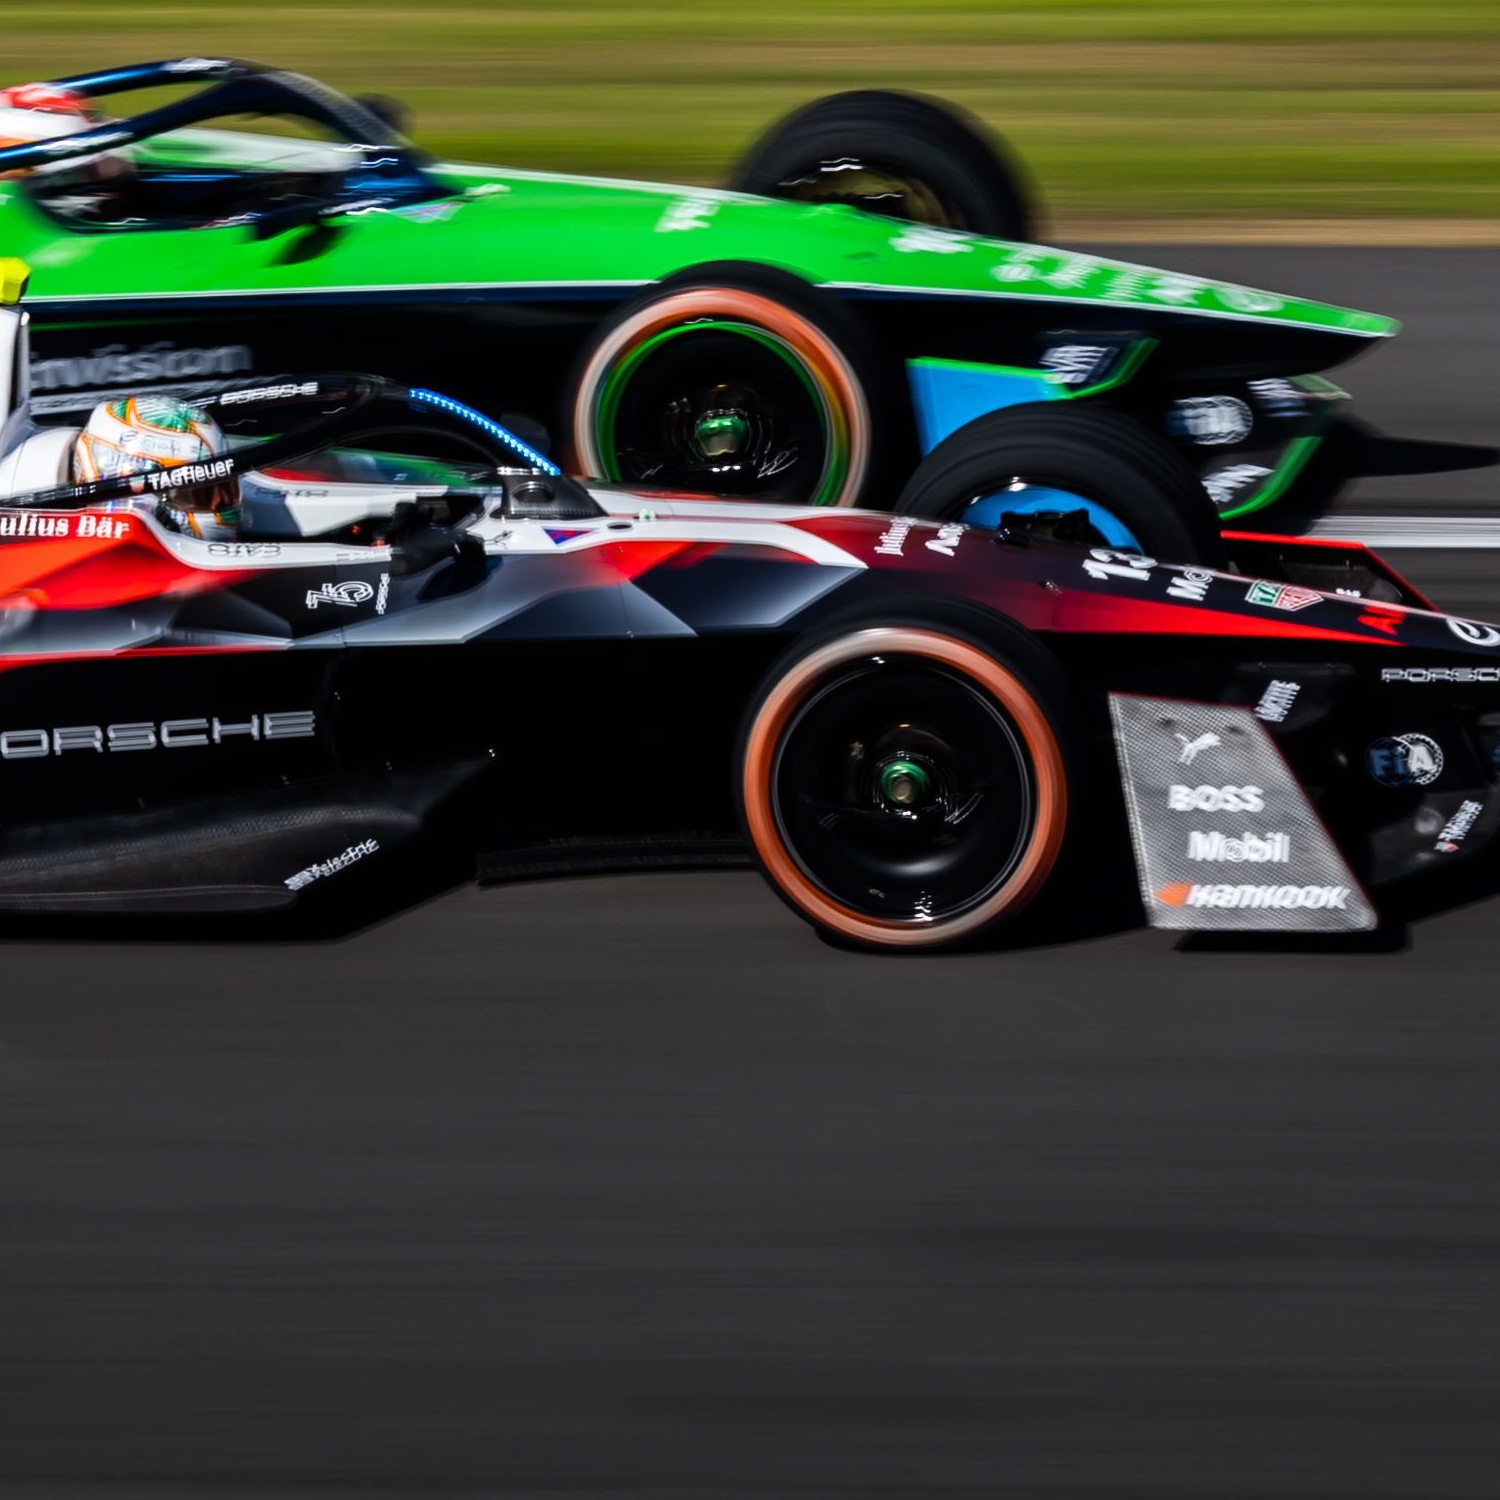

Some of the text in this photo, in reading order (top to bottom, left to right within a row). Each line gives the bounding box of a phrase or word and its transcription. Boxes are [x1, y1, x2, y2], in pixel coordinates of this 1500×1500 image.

[76, 515, 130, 540] Bär
[1168, 785, 1265, 812] BOSS
[1188, 830, 1291, 862] Mobil
